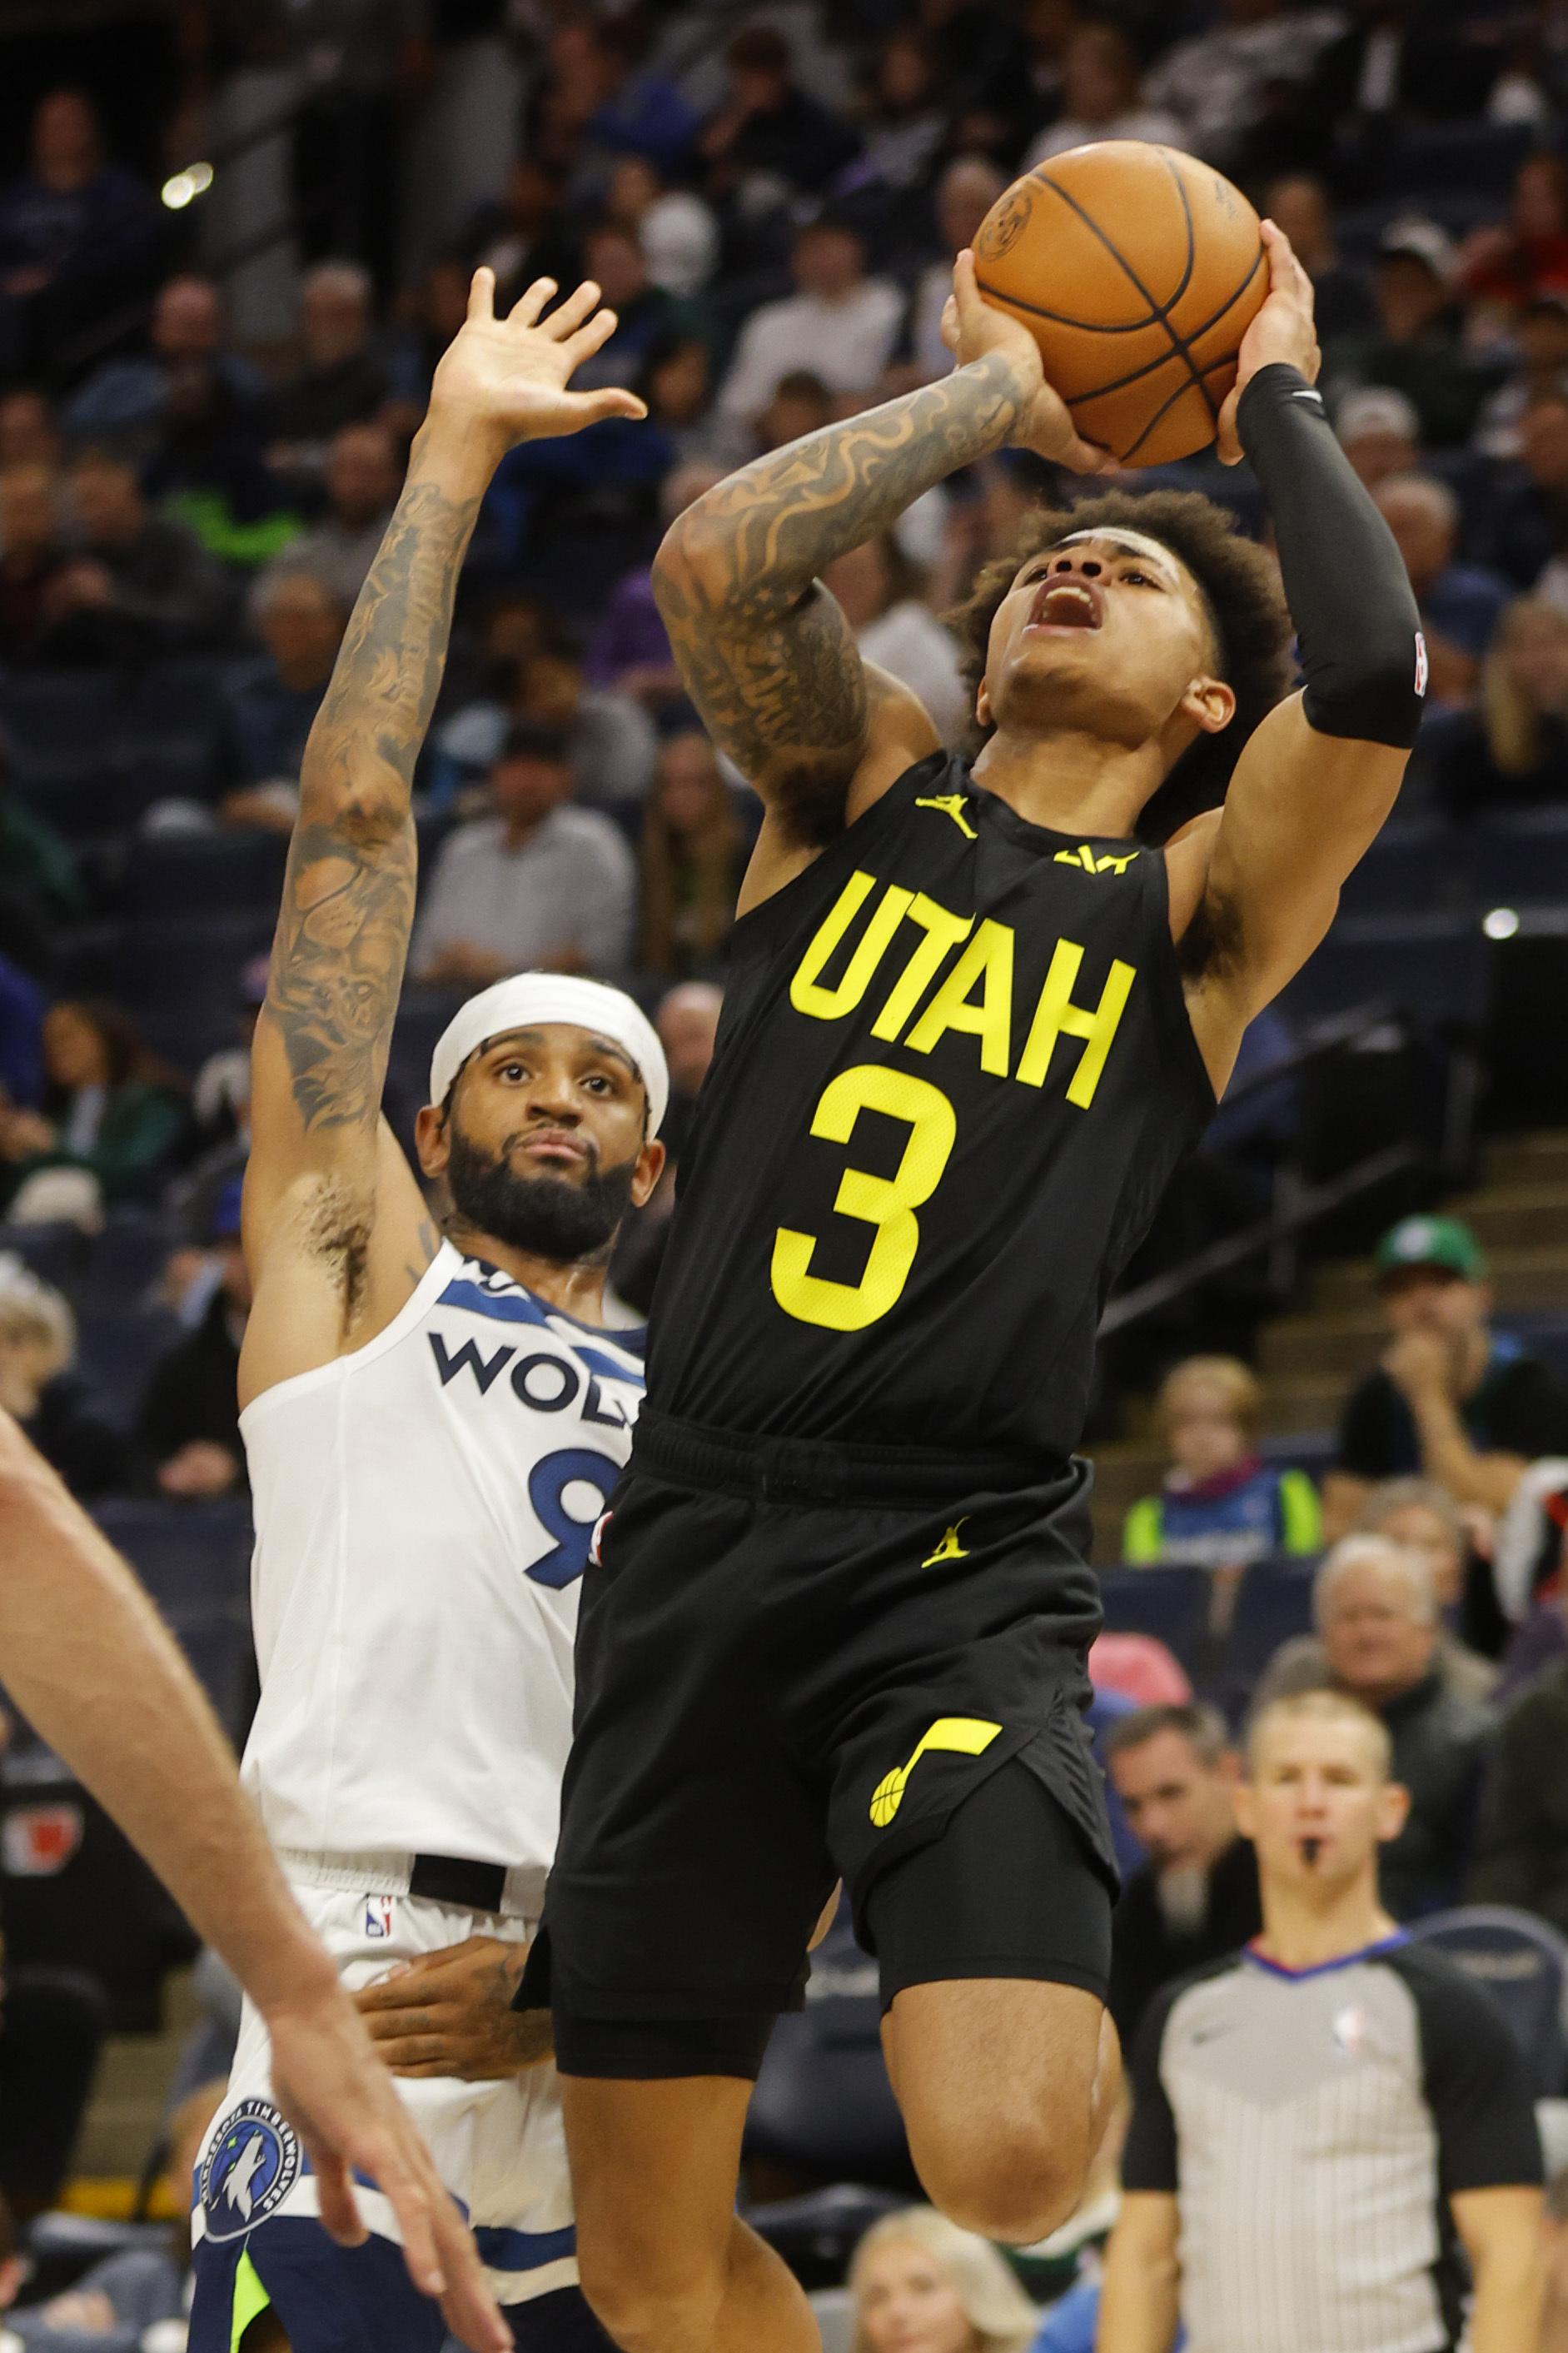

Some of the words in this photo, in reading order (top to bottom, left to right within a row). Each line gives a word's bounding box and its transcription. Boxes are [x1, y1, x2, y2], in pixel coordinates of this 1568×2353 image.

[790, 870, 1137, 1110] UTAH
[770, 1064, 957, 1332] 3
[523, 1448, 624, 1591] 9
